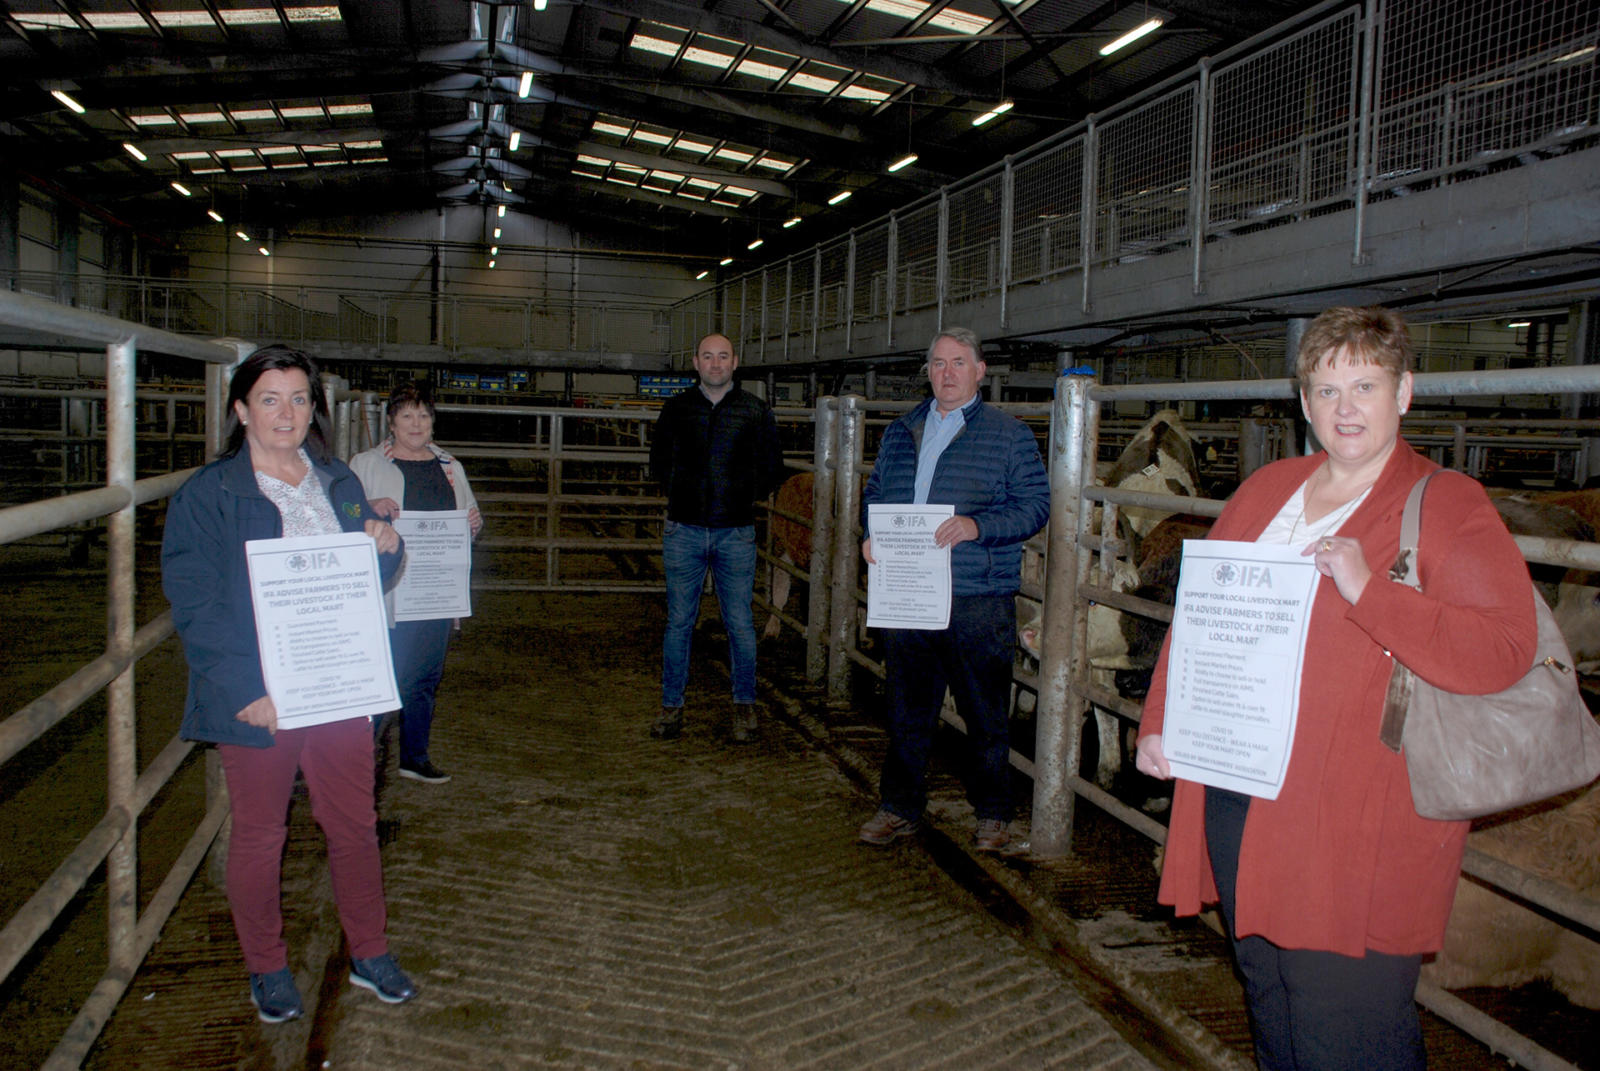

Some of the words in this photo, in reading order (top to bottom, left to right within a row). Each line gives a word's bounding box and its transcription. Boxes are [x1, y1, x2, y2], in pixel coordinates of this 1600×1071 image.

[908, 515, 927, 527] IFA
[311, 551, 341, 569] IFA
[1240, 565, 1273, 588] IFA
[276, 588, 304, 596] ADVISE
[305, 584, 340, 594] FARMERS
[268, 599, 291, 608] THEIR
[293, 595, 333, 606] LIVESTOCK
[345, 591, 367, 599] THEIR
[1184, 591, 1208, 599] SUPPORT
[1225, 593, 1245, 602] LOCAL
[1247, 596, 1282, 605] LIVESTOCK
[1282, 599, 1300, 607] MART
[296, 606, 321, 615] LOCAL
[322, 603, 344, 611] MART
[1184, 604, 1194, 612] IFA
[1195, 605, 1222, 615] ADVISE
[1223, 608, 1262, 619] FARMERS
[1264, 611, 1275, 621] TO
[1275, 612, 1295, 622] SELL
[1186, 616, 1207, 627] THEIR
[1208, 619, 1254, 632] LIVESTOCK
[1254, 623, 1265, 632] AT
[1265, 624, 1289, 635] THEIR
[1209, 632, 1235, 643] LOCAL
[1236, 635, 1260, 645] MART
